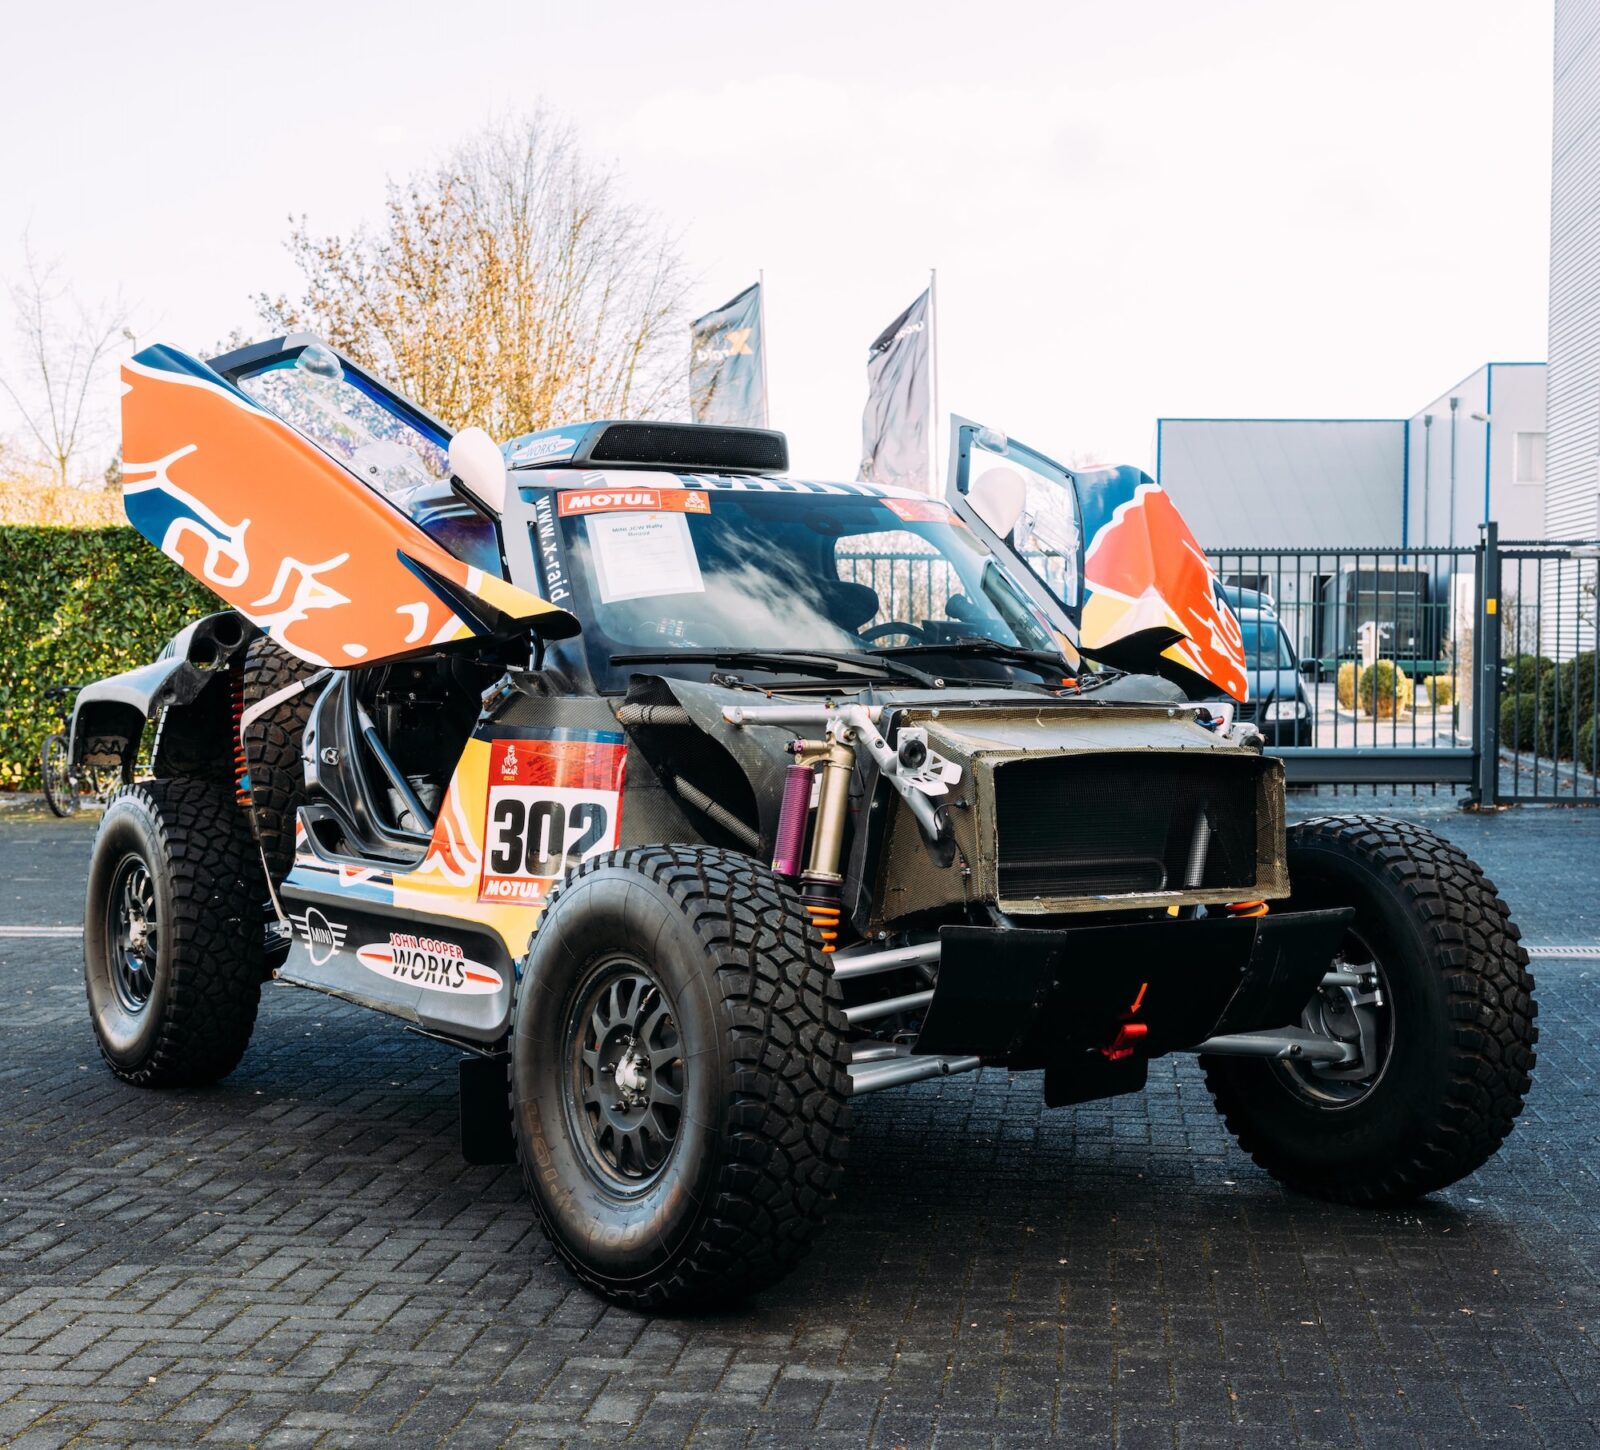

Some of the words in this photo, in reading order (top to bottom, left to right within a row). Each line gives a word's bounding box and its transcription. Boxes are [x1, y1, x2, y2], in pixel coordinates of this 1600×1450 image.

[527, 441, 558, 457] WORKS
[568, 494, 655, 509] MOTUL
[491, 799, 607, 877] 302
[485, 880, 540, 898] MOTUL
[310, 926, 332, 945] MINI
[390, 933, 417, 949] JOHN
[420, 938, 463, 959] COOPER
[393, 948, 465, 988] WORKS
